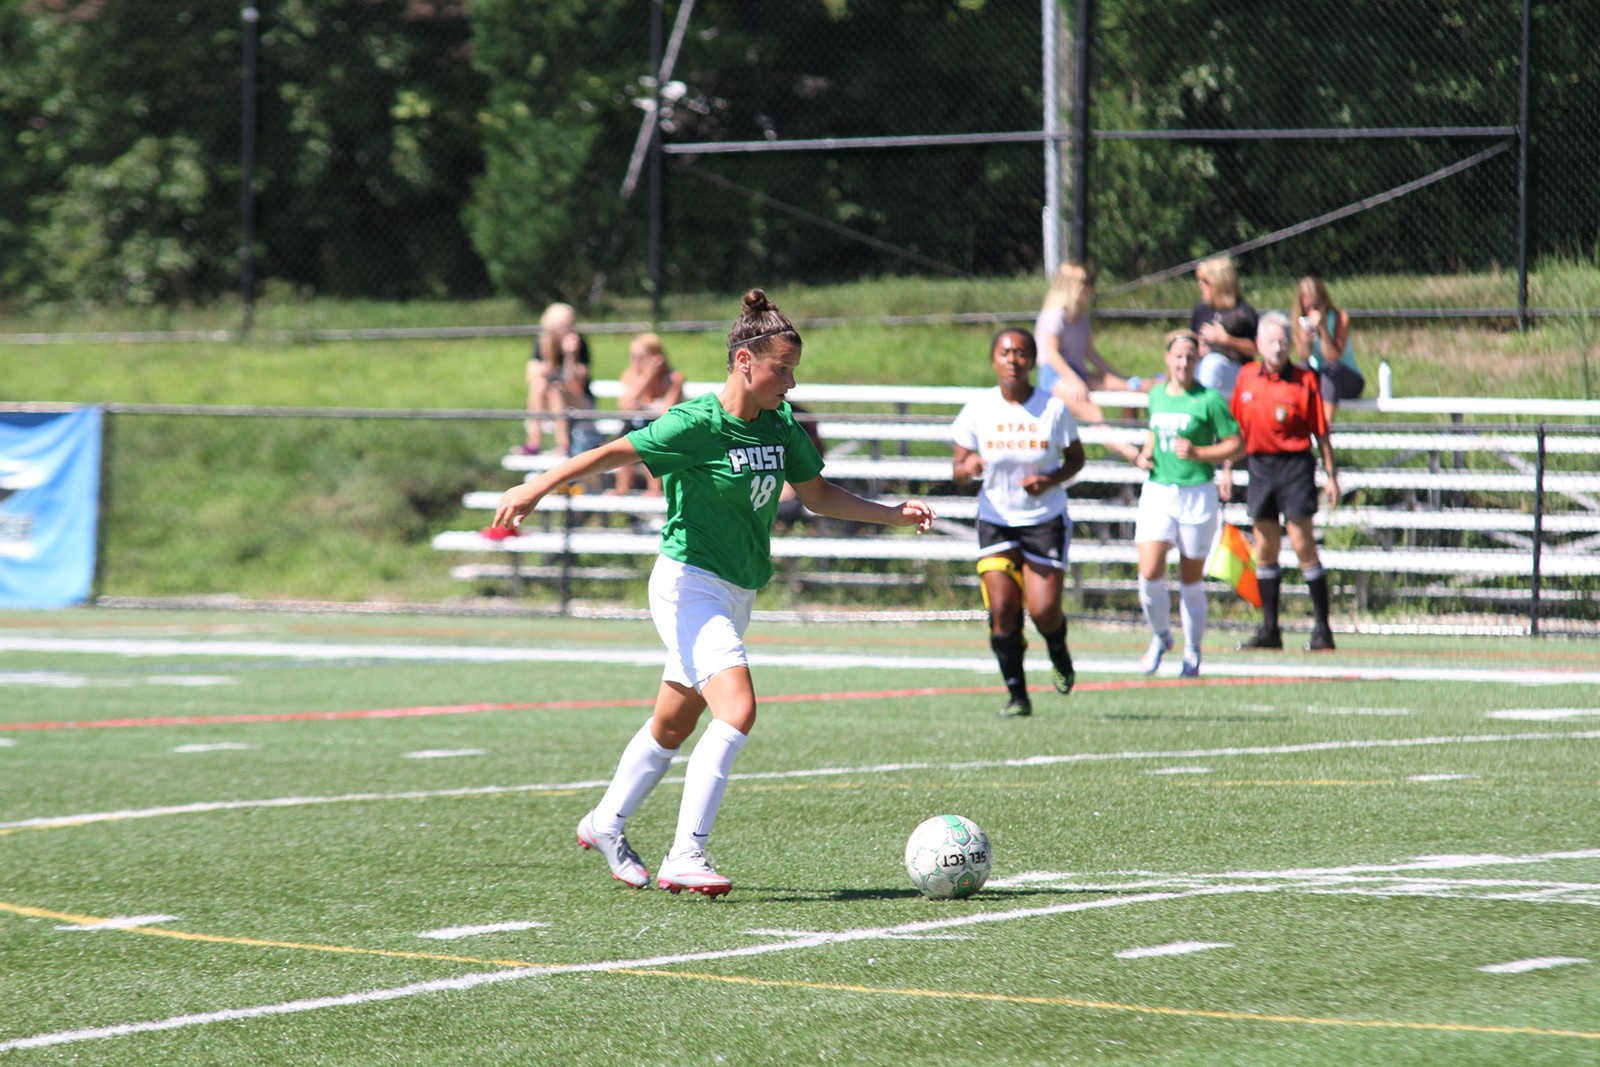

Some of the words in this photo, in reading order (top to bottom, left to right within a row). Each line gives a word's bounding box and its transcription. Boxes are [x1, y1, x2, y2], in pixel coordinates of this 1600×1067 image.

[728, 445, 786, 473] POST
[750, 475, 777, 511] 18
[942, 851, 987, 868] SELECT
